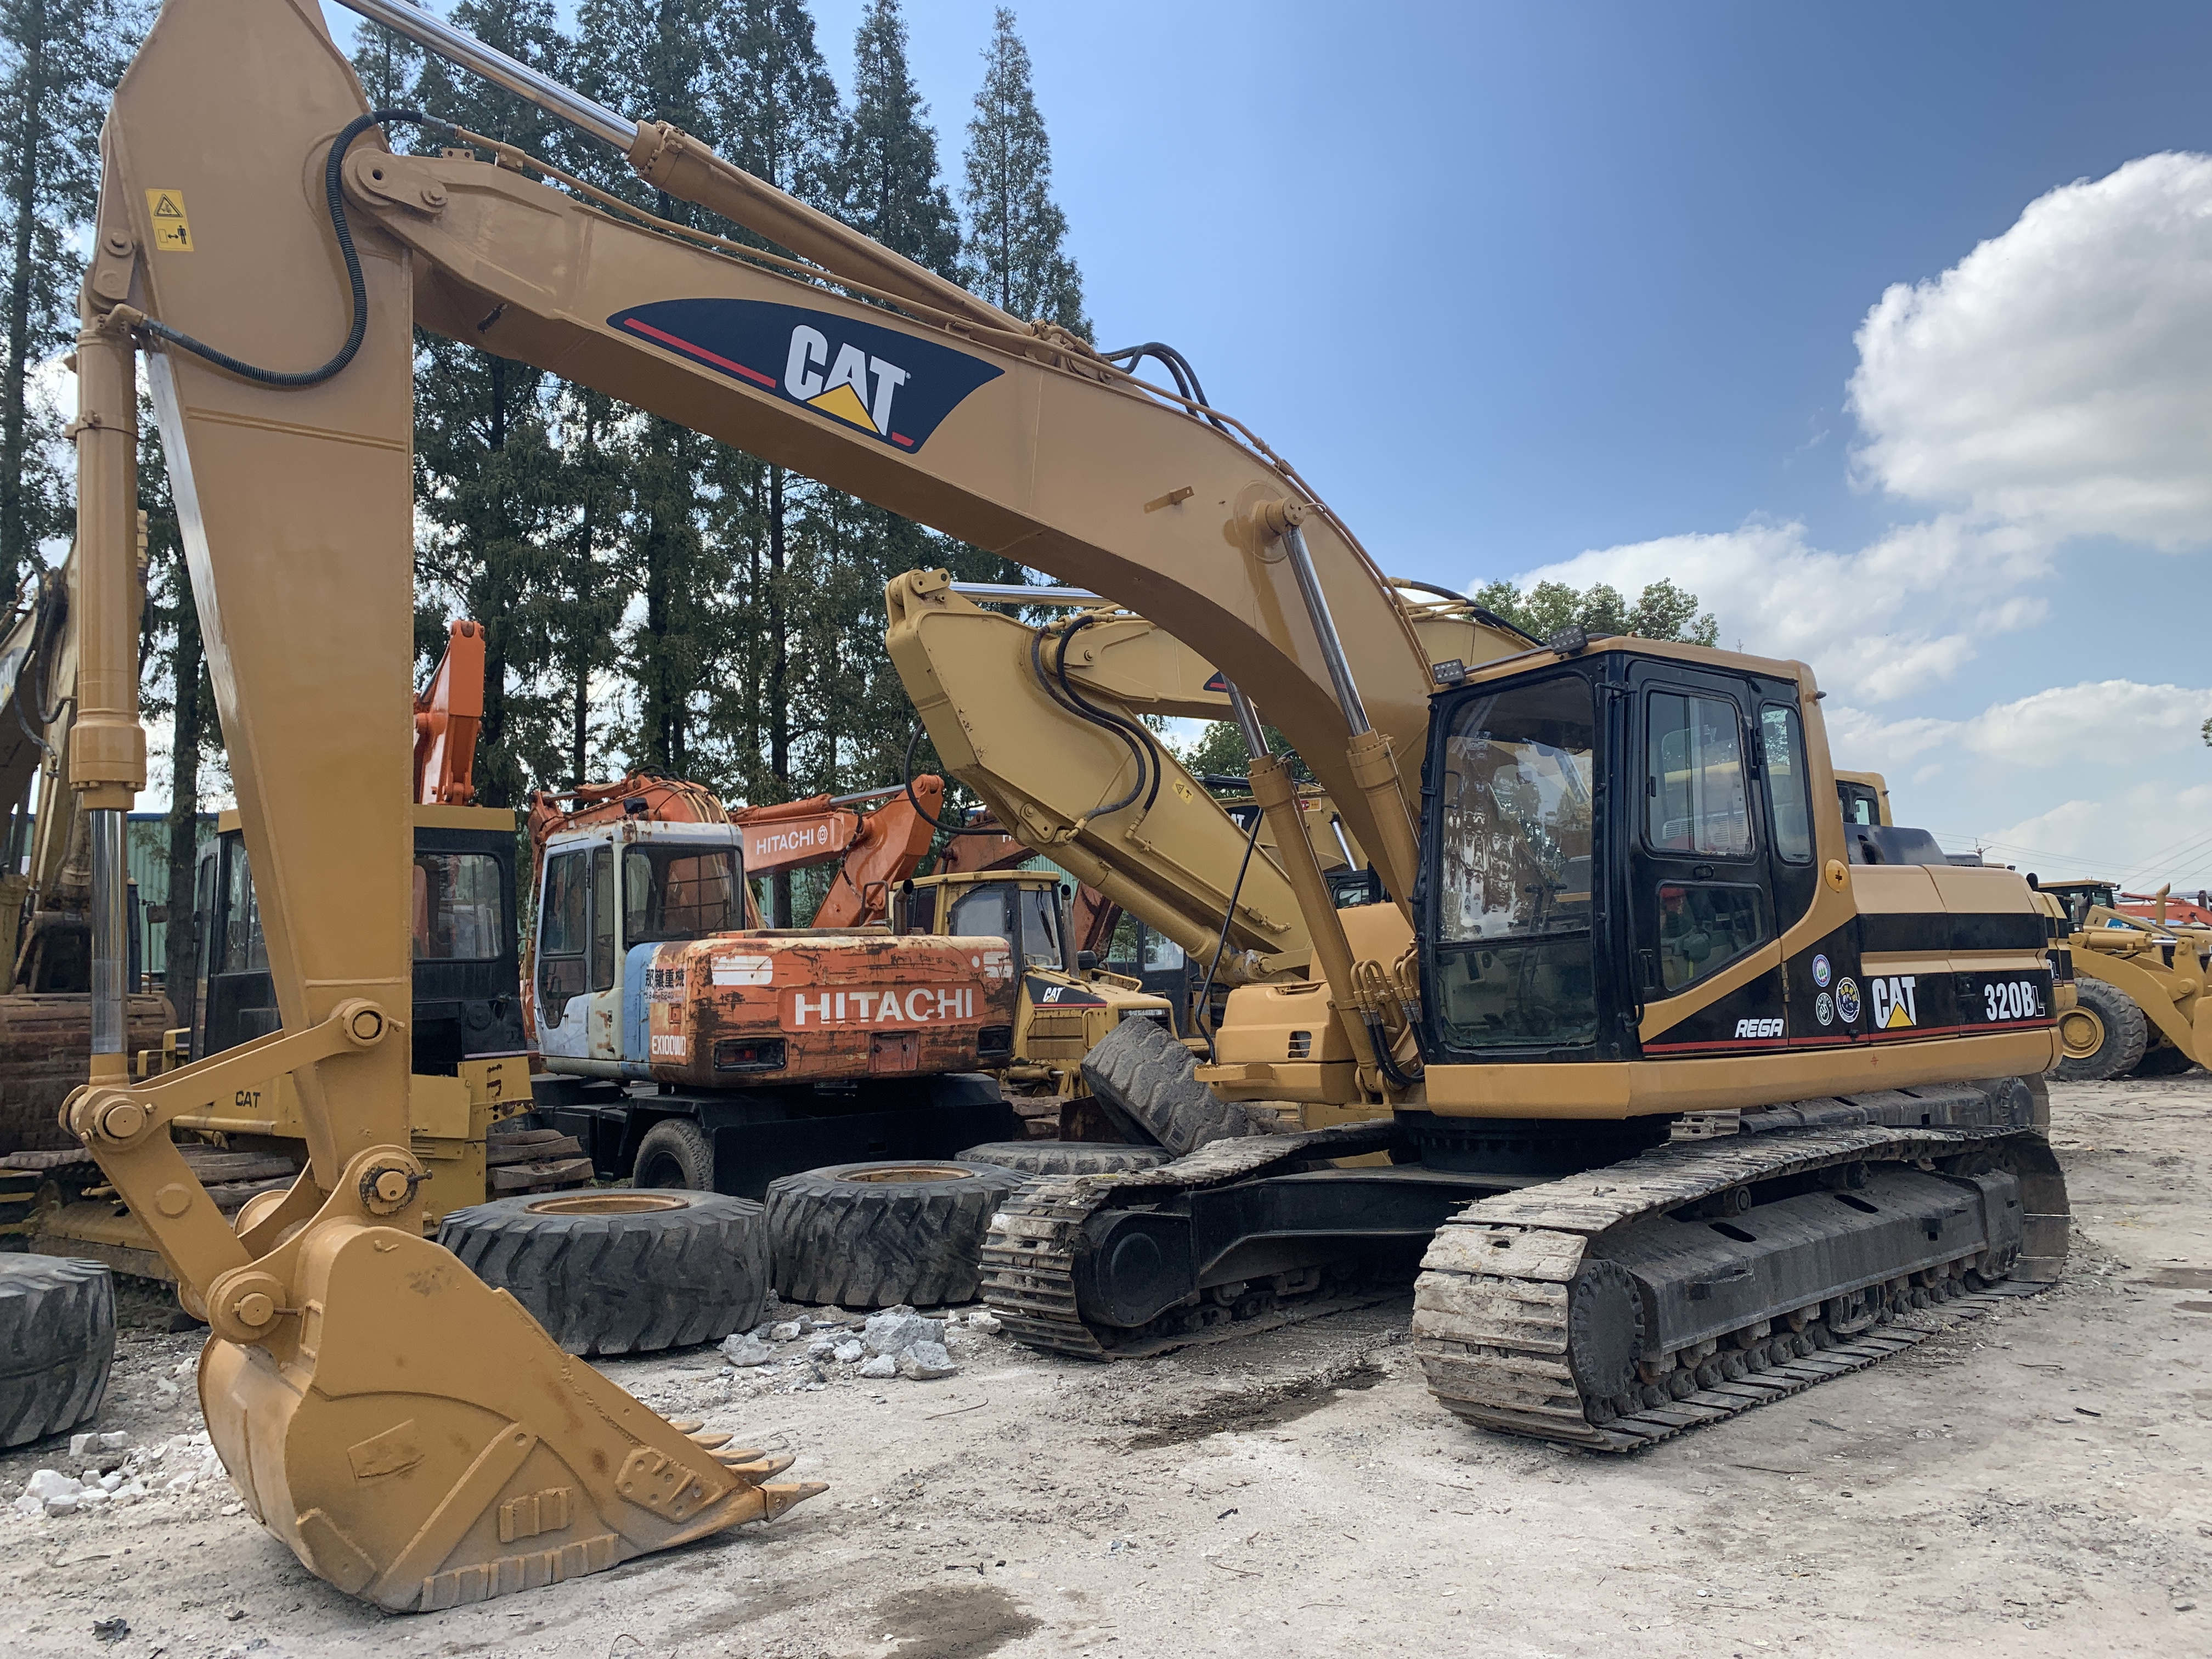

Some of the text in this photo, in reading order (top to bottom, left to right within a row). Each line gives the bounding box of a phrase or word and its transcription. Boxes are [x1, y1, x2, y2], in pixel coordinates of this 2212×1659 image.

[785, 324, 906, 436] CAT
[1230, 813, 1245, 828] AT
[757, 828, 814, 855] HITACHI
[795, 988, 973, 1025] HITACHI
[1042, 987, 1064, 1003] CAT
[1872, 976, 1917, 1029] CAT
[1735, 1018, 1784, 1037] REGA
[235, 1091, 261, 1108] CAT
